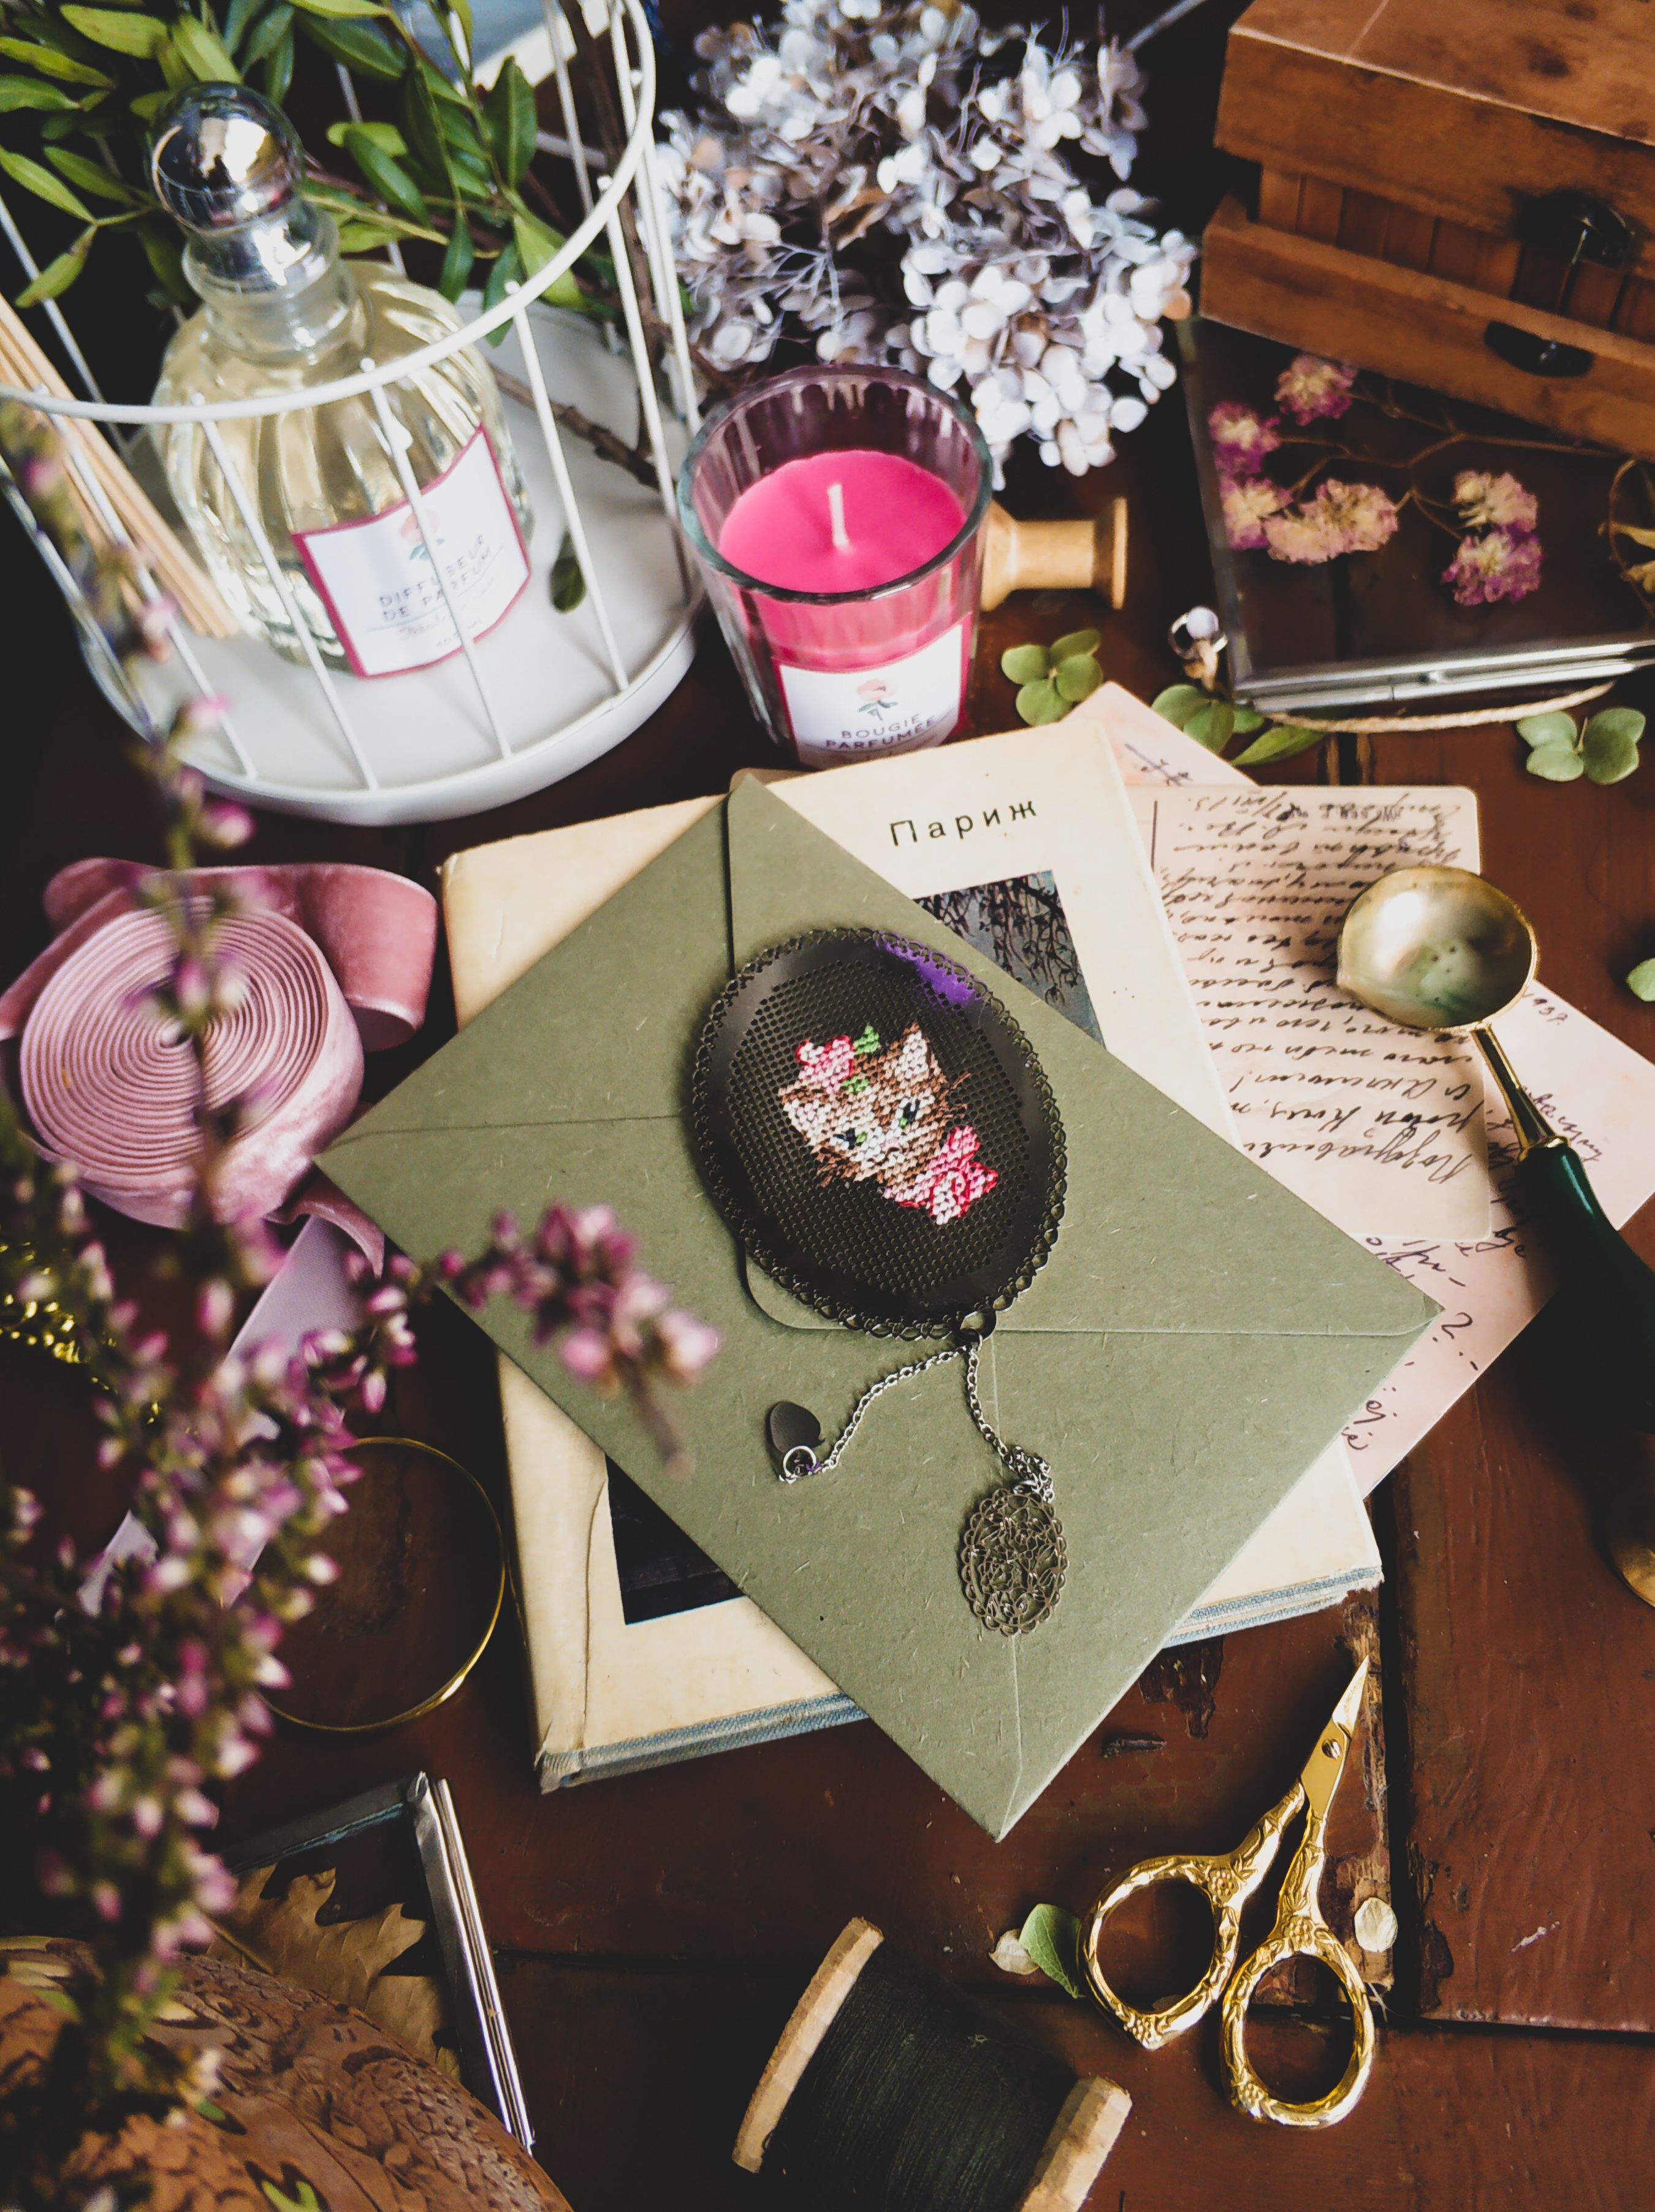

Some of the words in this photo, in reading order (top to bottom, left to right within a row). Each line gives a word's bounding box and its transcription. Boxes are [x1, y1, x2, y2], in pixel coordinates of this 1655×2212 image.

[382, 606, 409, 621] DE
[841, 713, 920, 739] BOUGIE
[889, 800, 1037, 846] Париж
